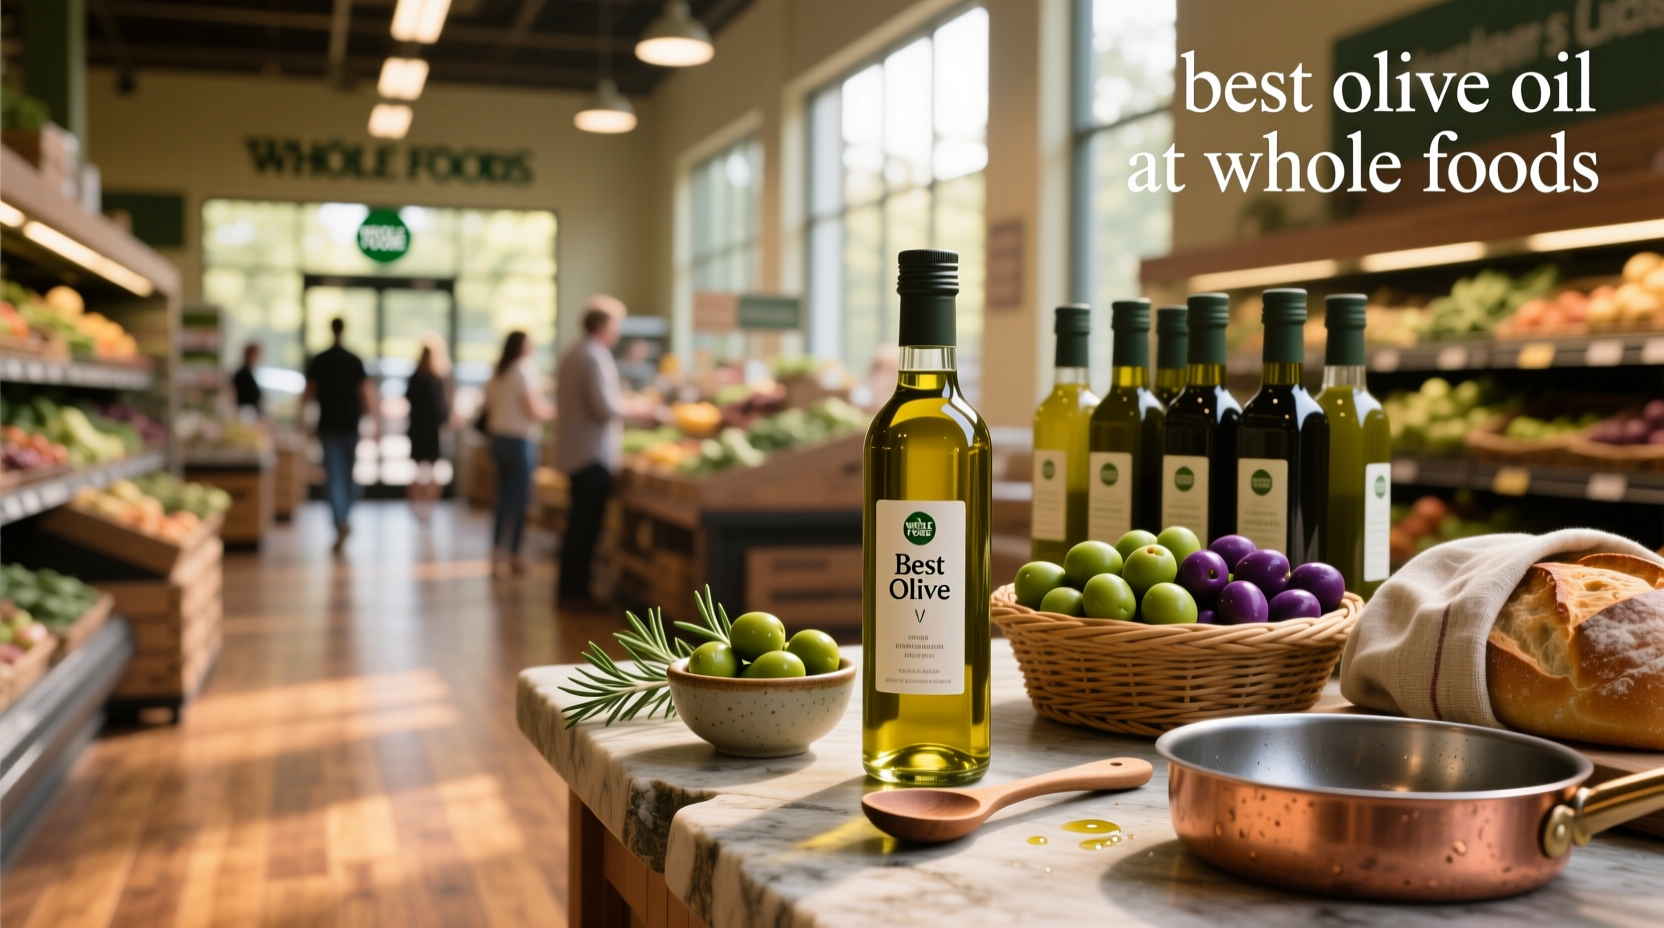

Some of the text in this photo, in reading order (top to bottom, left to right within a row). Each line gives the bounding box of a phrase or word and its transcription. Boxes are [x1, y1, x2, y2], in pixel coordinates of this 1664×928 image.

[245, 137, 534, 186] WHOLE FOODS
[894, 553, 945, 576] Best
[889, 578, 951, 601] Olive
